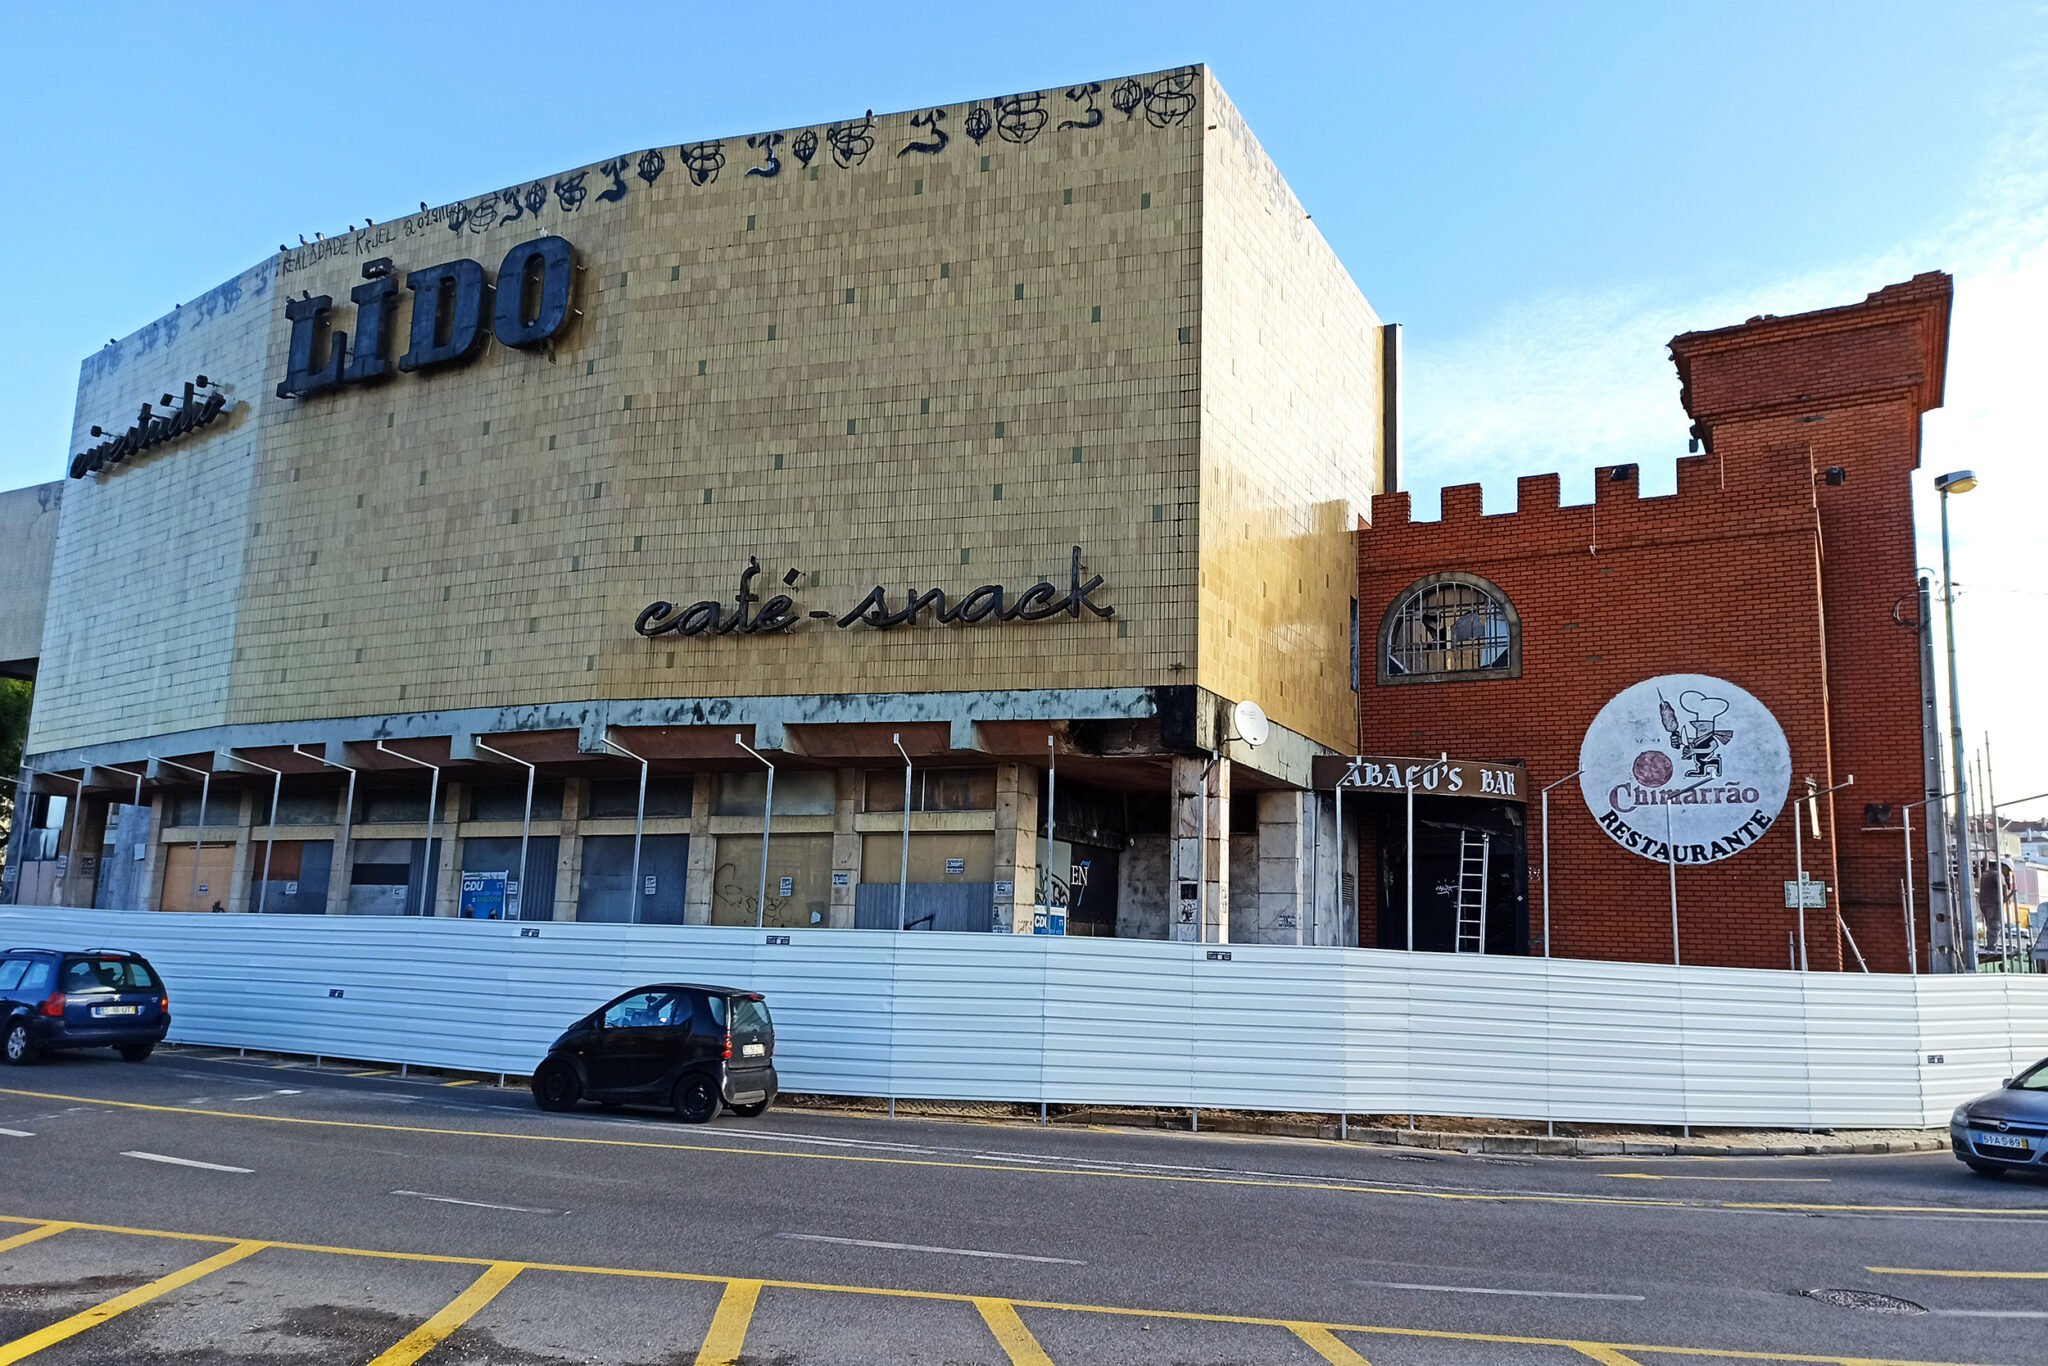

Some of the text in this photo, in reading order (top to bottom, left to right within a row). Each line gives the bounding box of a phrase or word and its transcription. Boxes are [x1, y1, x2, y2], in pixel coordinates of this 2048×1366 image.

[1480, 768, 1516, 796] BAR
[1609, 782, 1760, 813] Chimarrão
[1599, 809, 1772, 862] RESTAURANTE
[464, 881, 484, 891] CDU
